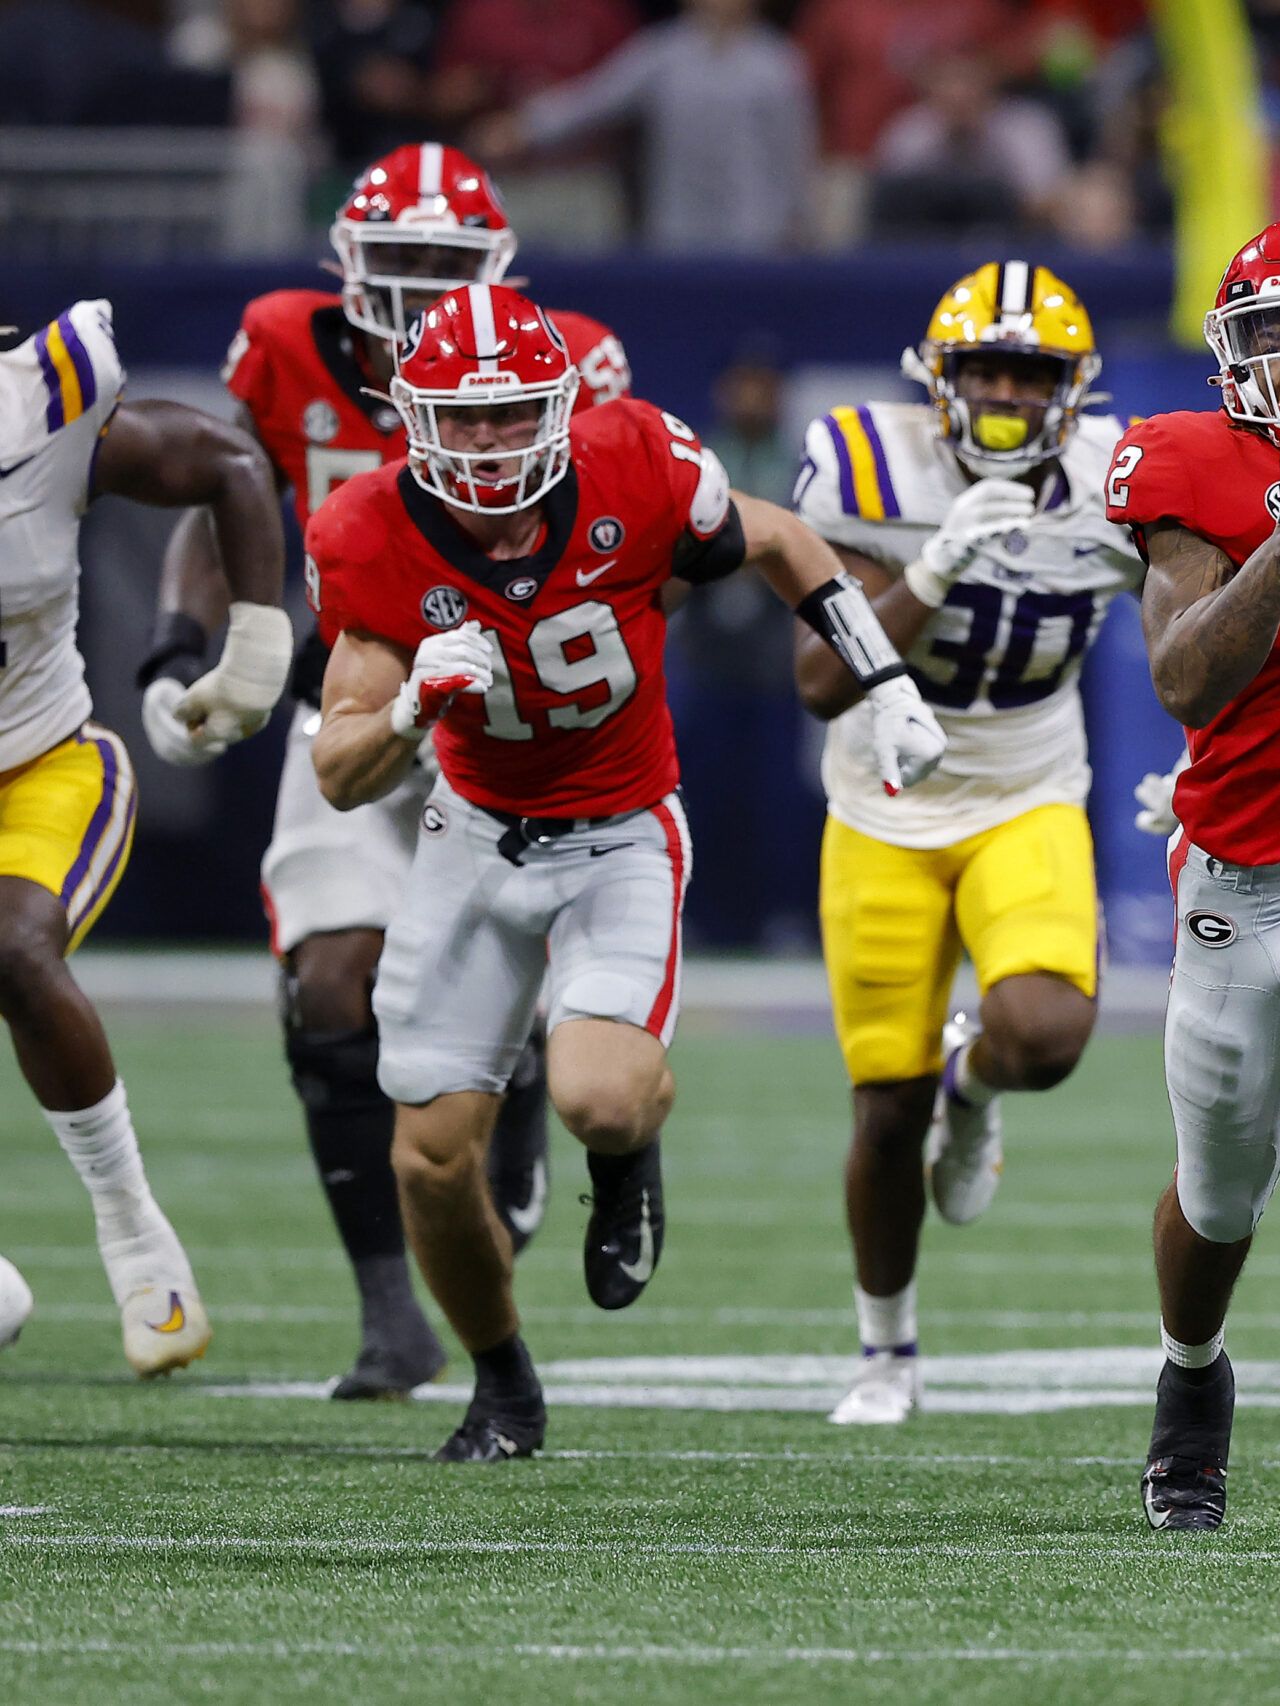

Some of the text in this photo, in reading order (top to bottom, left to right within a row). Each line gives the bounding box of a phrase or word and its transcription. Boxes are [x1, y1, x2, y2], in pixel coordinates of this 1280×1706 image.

[468, 376, 511, 386] DAWGS
[1107, 444, 1145, 509] 2
[423, 587, 467, 628] SEC
[508, 579, 537, 598] G
[903, 581, 1095, 710] 30
[481, 599, 638, 741] 19
[1191, 914, 1236, 942] G
